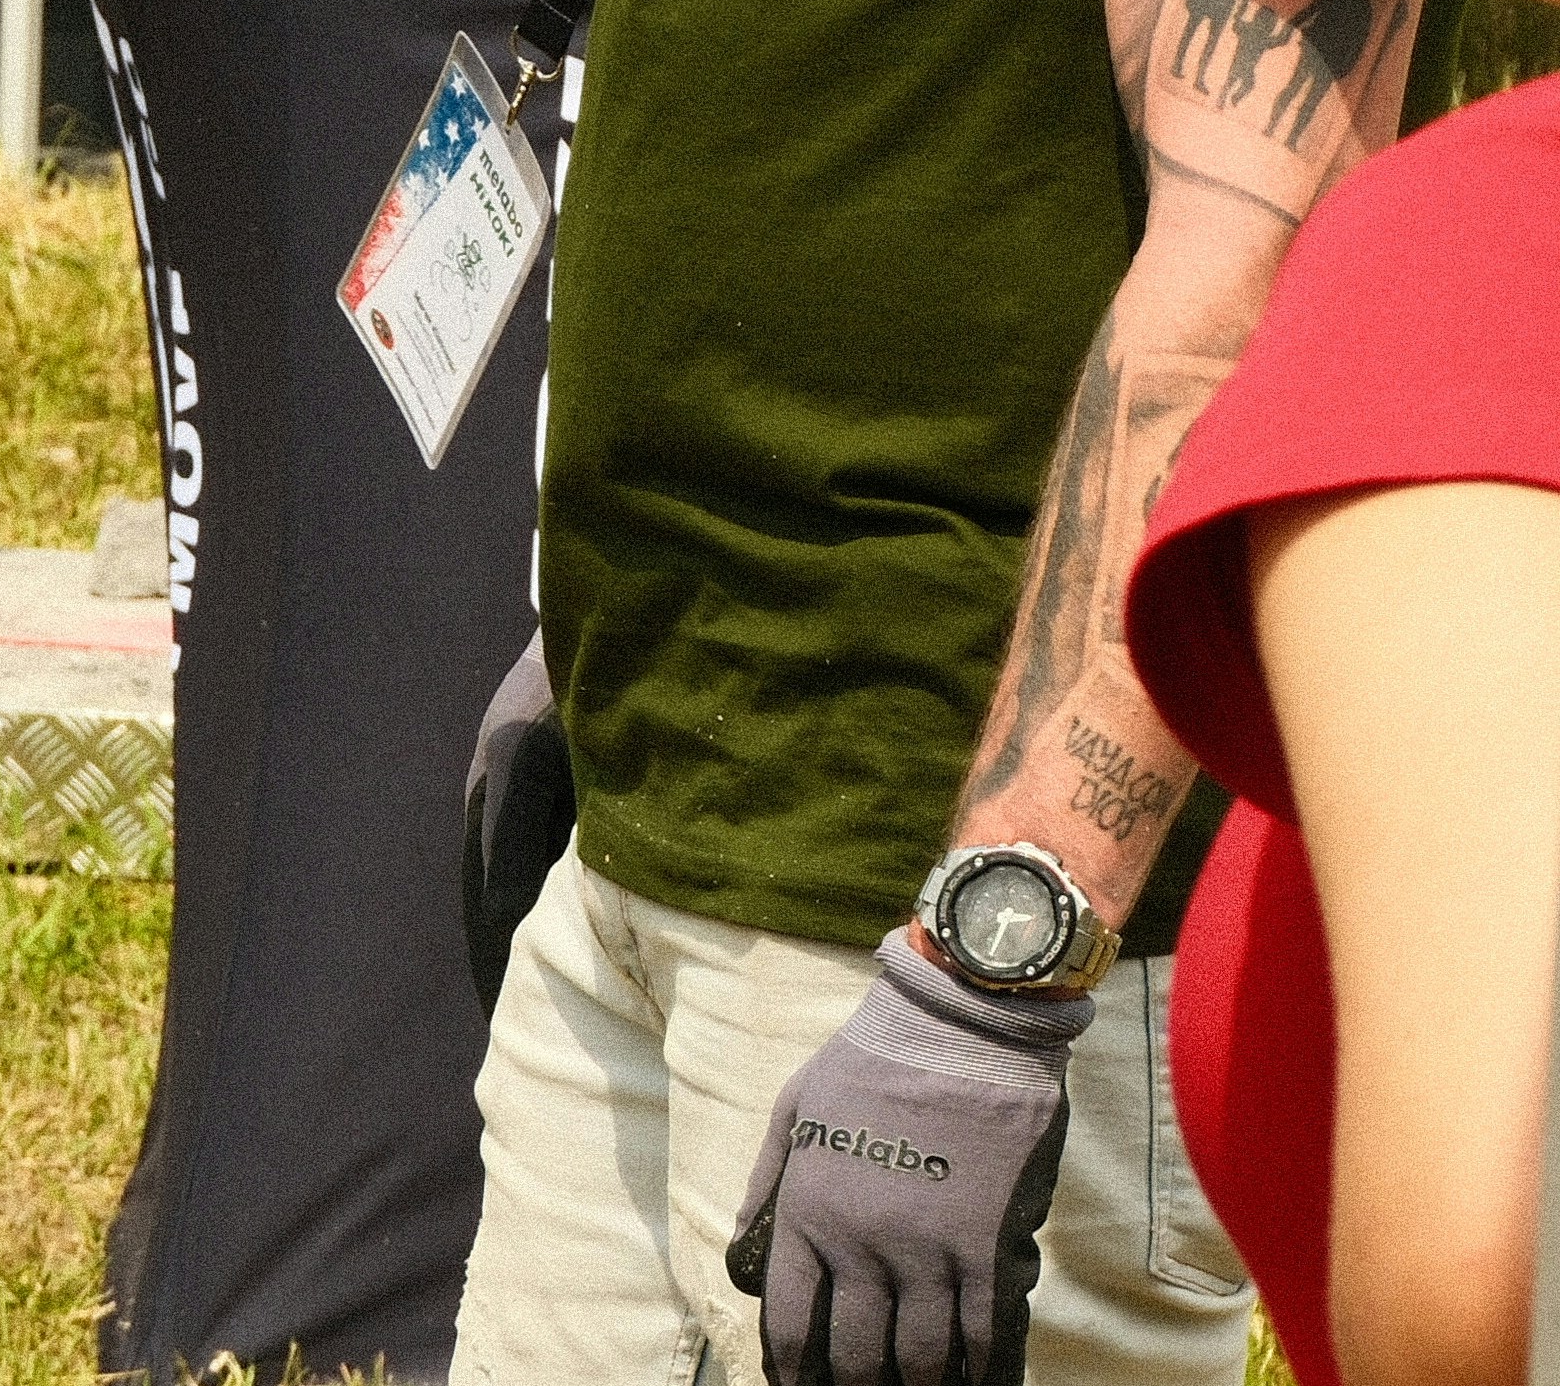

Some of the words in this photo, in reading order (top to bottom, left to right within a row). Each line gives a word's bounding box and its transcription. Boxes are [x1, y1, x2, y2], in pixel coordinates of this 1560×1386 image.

[470, 172, 516, 258] HiKOKI
[478, 149, 524, 239] metabo
[790, 1117, 952, 1182] metabo
